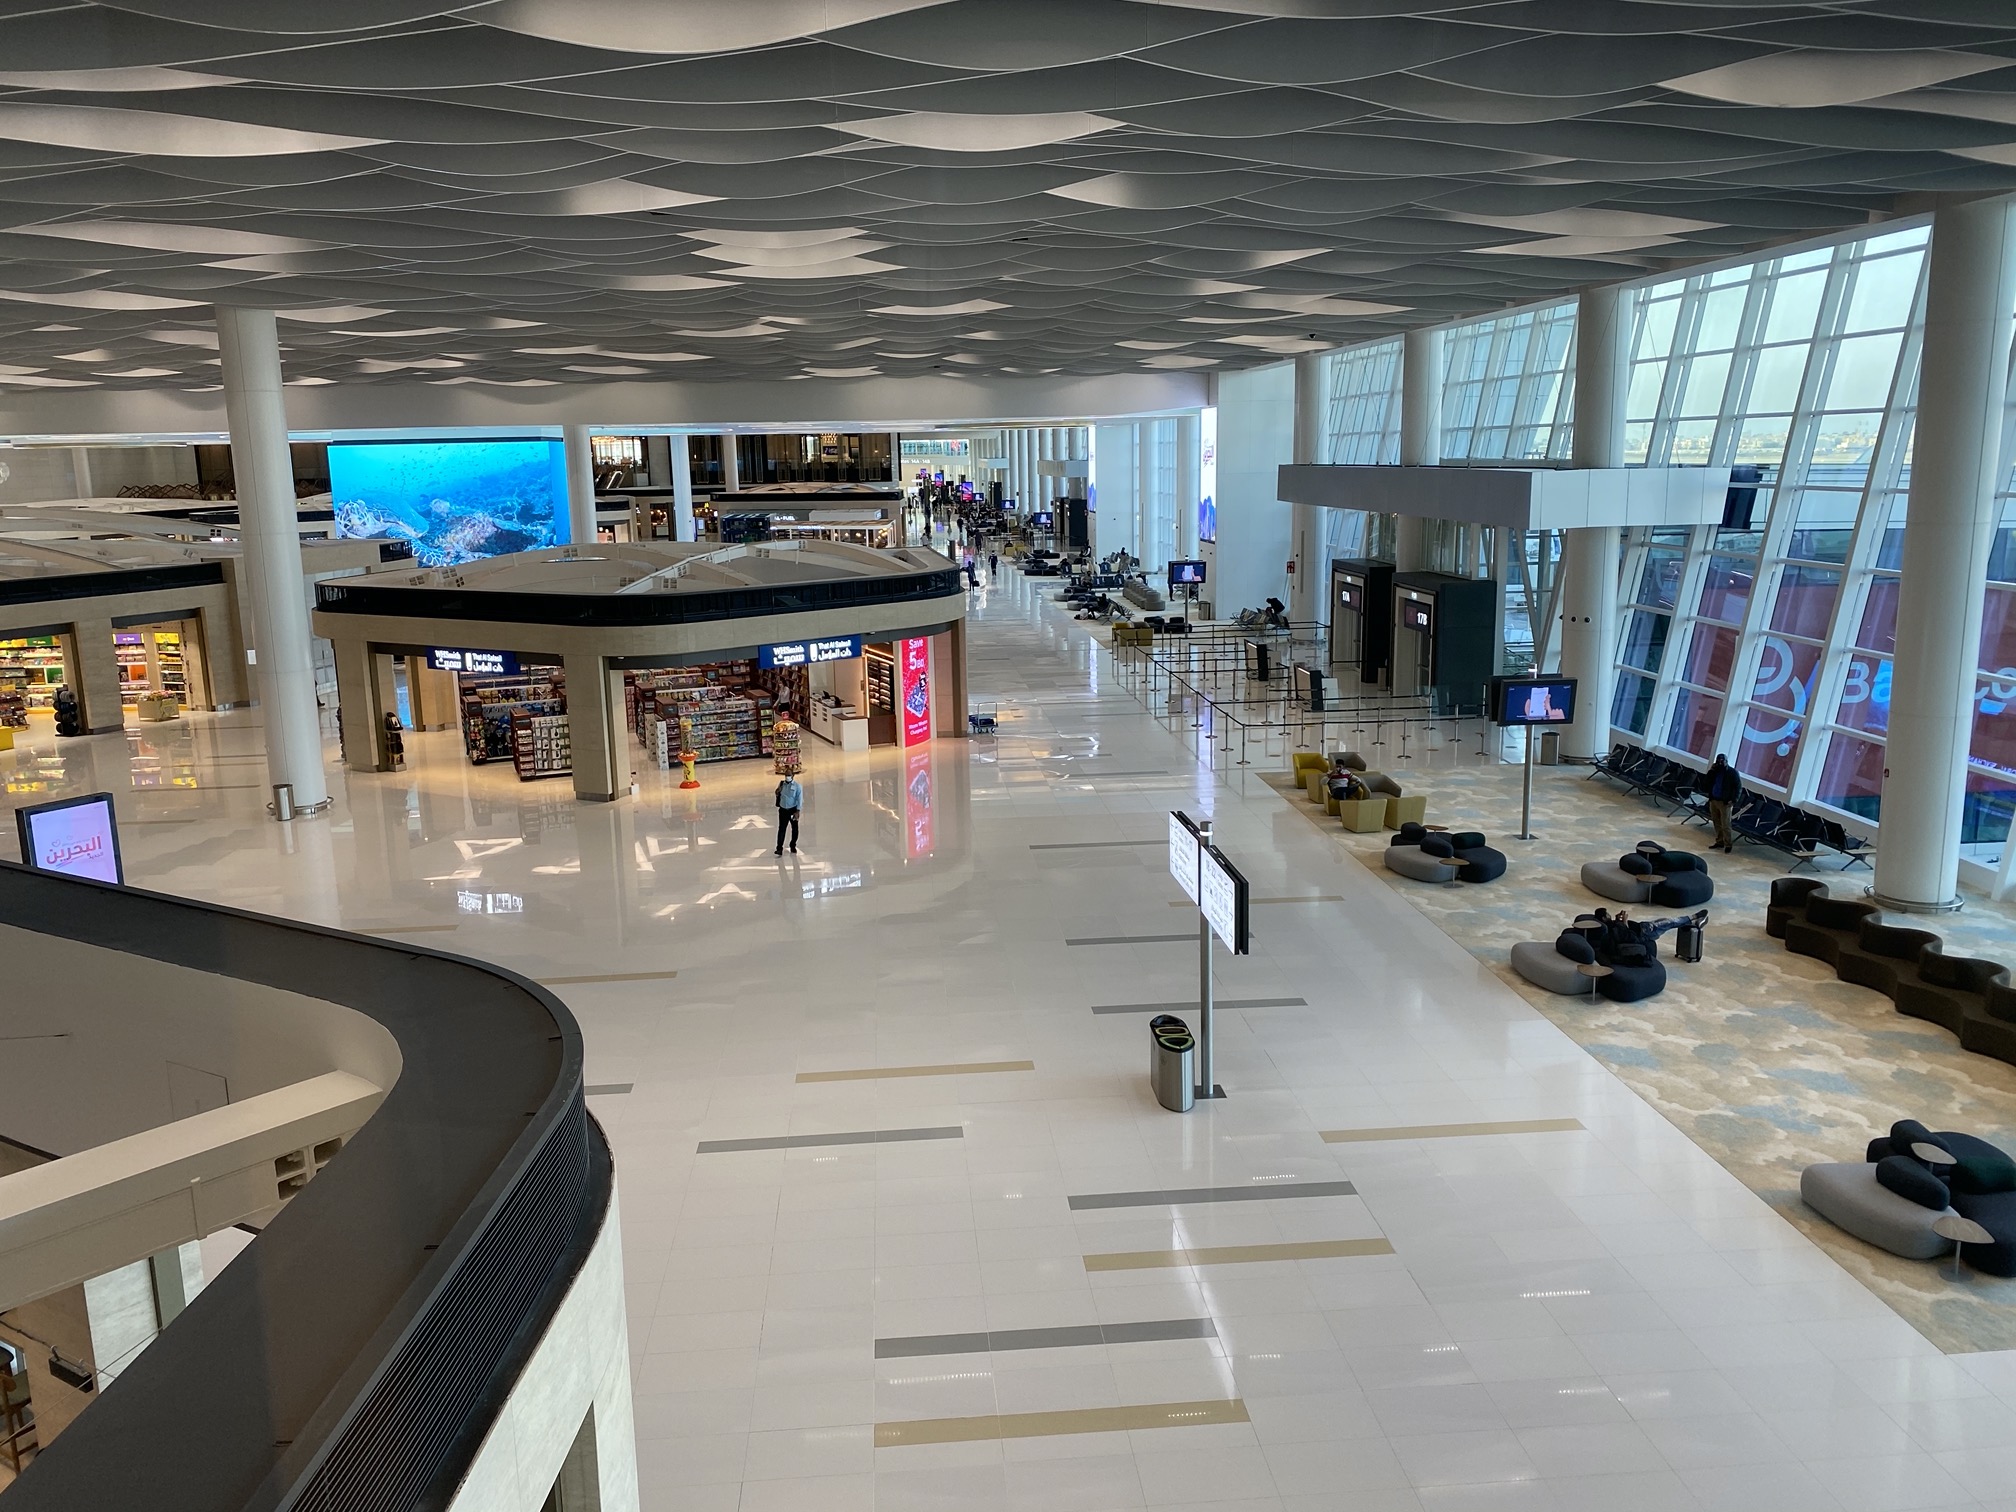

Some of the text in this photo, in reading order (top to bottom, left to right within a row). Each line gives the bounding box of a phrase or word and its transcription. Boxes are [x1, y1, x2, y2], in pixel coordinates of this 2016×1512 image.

[1342, 590, 1351, 602] 17A
[1417, 611, 1428, 626] 17B
[818, 642, 829, 650] That
[908, 638, 924, 650] Save
[434, 649, 461, 659] WHSmith
[773, 645, 805, 656] WHSmith
[46, 835, 102, 865] البحرين
